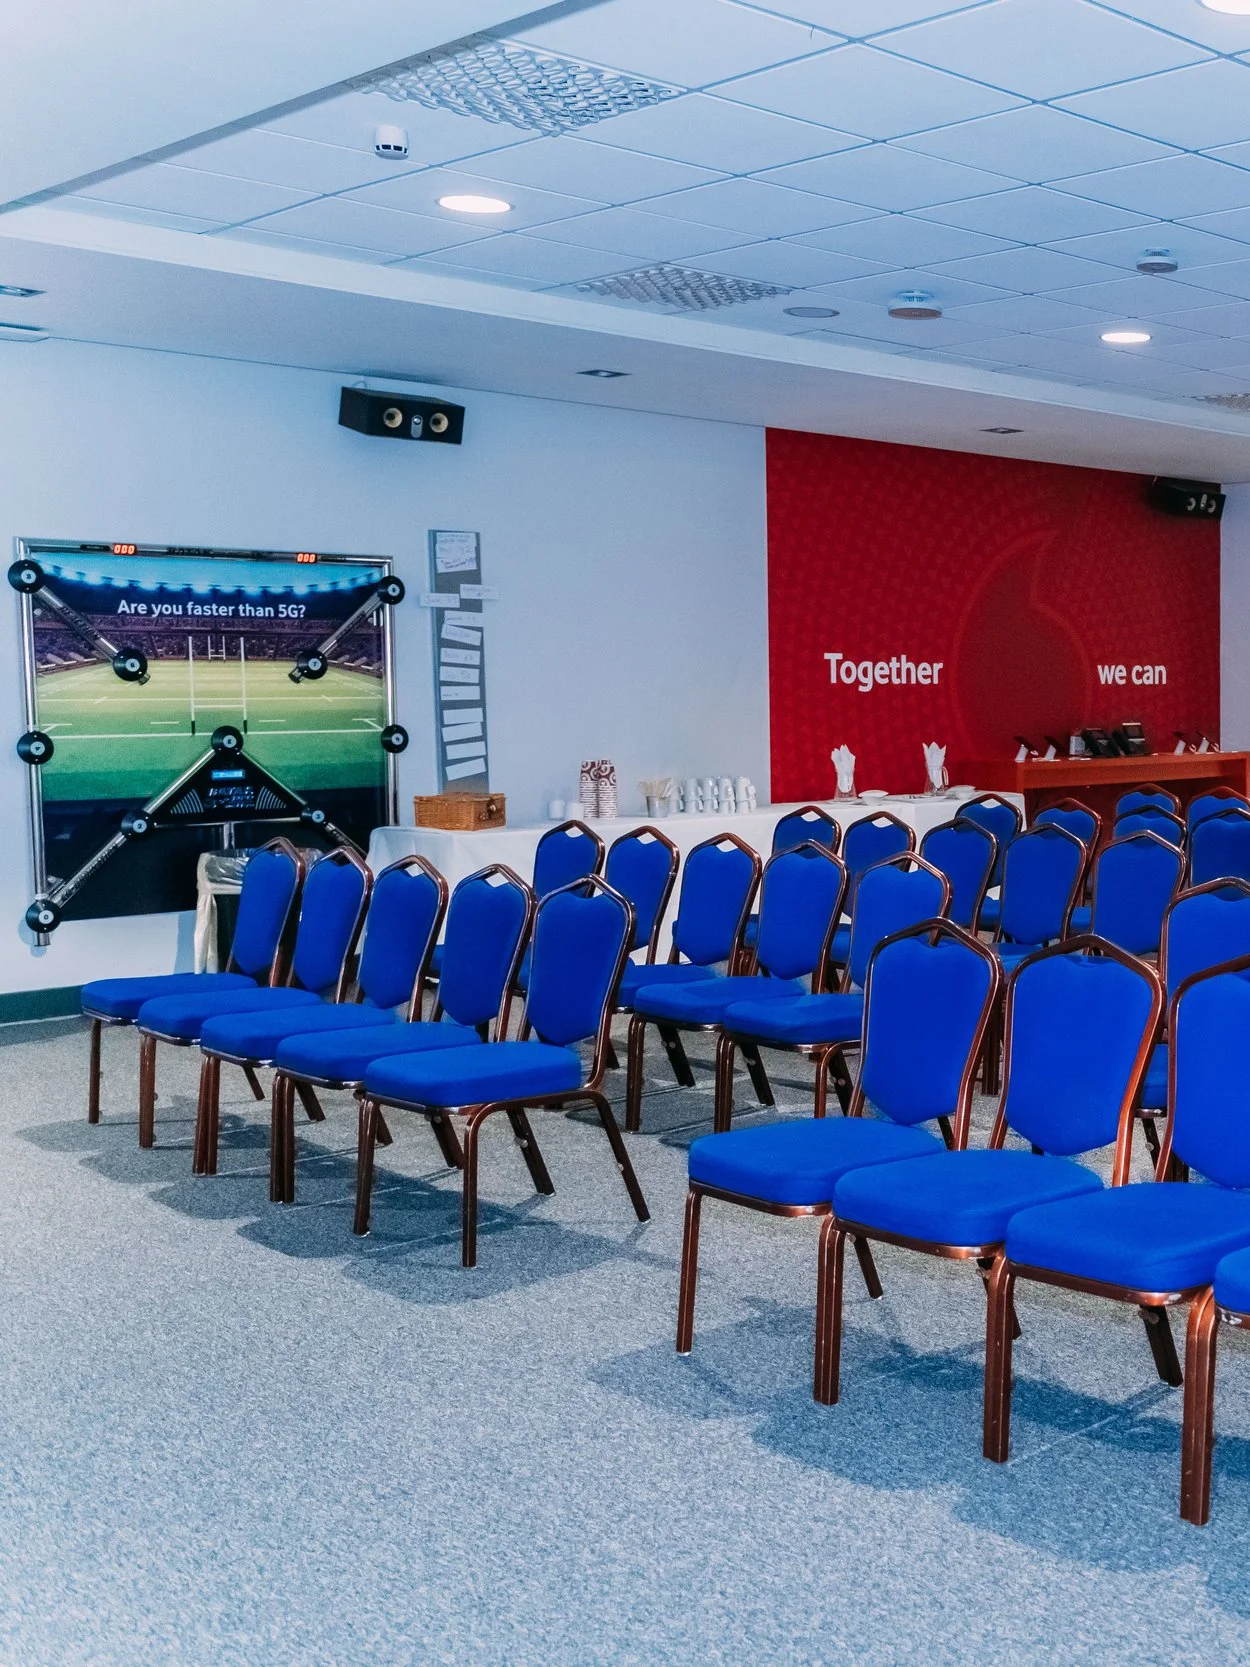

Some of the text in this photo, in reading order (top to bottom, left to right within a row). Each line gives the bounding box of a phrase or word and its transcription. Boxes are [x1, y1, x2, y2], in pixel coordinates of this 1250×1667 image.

[114, 544, 135, 555] 000
[297, 553, 316, 563] 000
[117, 600, 306, 618] Are you faster than 5G?
[824, 653, 1167, 692] Together we can
